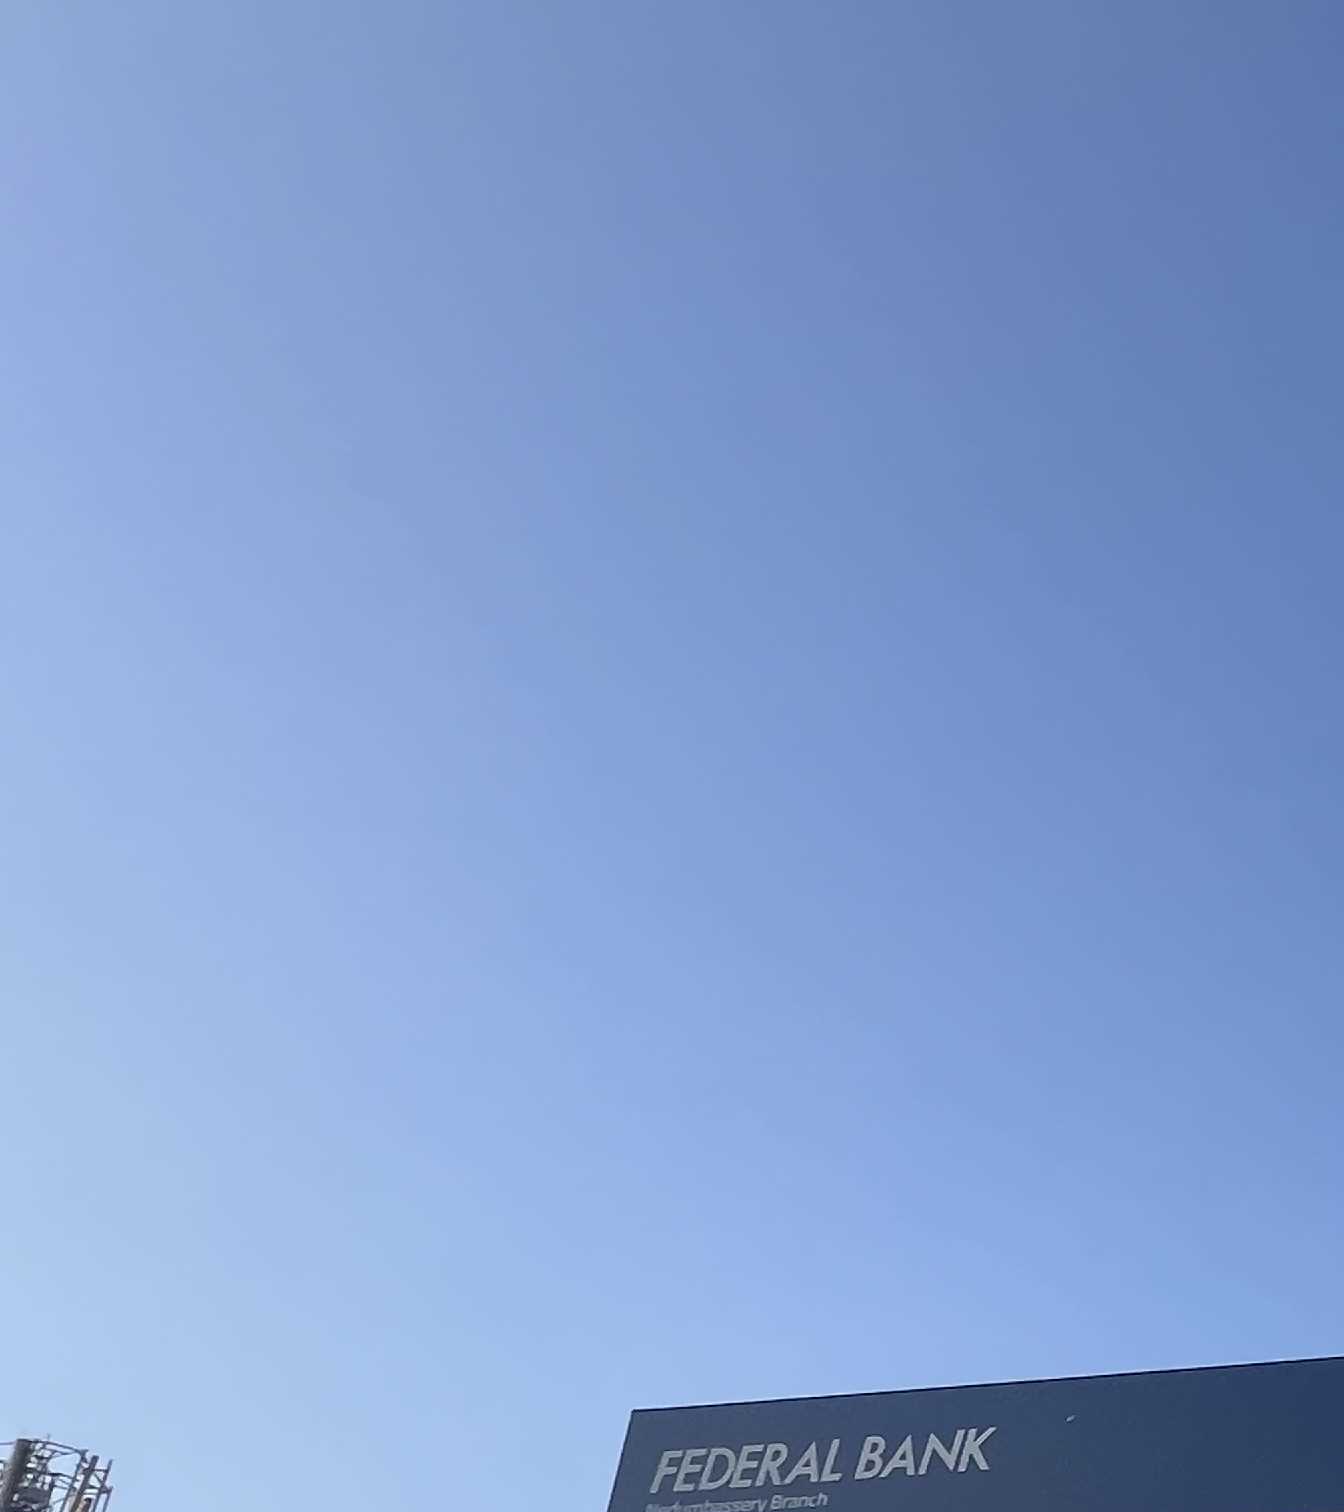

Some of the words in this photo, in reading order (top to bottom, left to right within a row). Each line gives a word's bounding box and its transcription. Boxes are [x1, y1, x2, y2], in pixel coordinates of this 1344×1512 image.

[649, 1438, 842, 1495] FEDERAL
[853, 1426, 996, 1481] BANK
[770, 1491, 828, 1511] Branch
